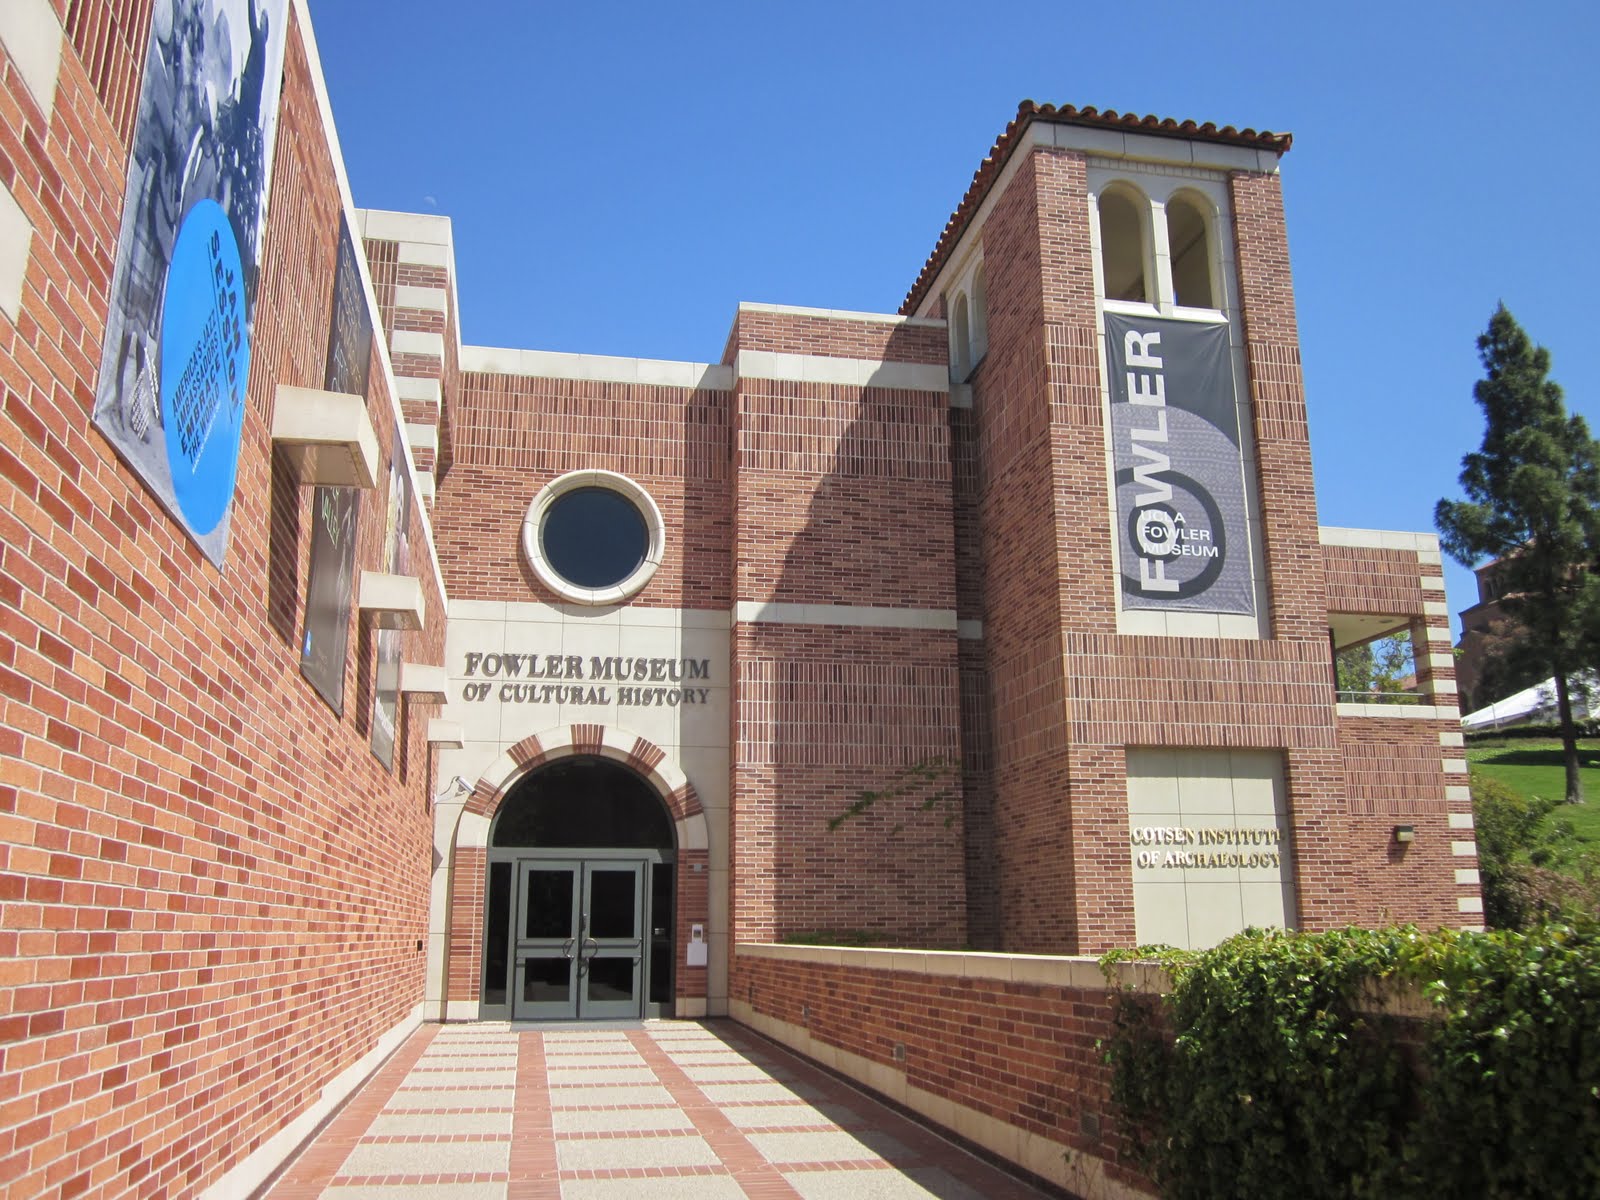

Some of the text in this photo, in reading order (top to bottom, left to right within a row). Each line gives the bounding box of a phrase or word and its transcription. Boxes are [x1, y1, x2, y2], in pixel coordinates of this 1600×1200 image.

[211, 229, 239, 413] SESSION
[225, 267, 242, 353] JAM
[172, 309, 217, 417] AMERICA'S JAZZ
[177, 331, 219, 437] AMBASSADORS
[181, 353, 221, 456] EMBRACE
[187, 432, 201, 464] THE
[200, 382, 220, 436] WORLD
[1124, 330, 1180, 593] FOWLER
[1140, 510, 1187, 524] UCLA
[1142, 526, 1211, 541] FOWLER
[1143, 543, 1219, 558] MUSEUM
[462, 682, 711, 707] OF CULTURAL HISTORY
[463, 652, 711, 682] FOWLER MUSEUM
[1131, 826, 1195, 846] COTSEN
[1136, 850, 1281, 869] OF ARCHAEOLOGY
